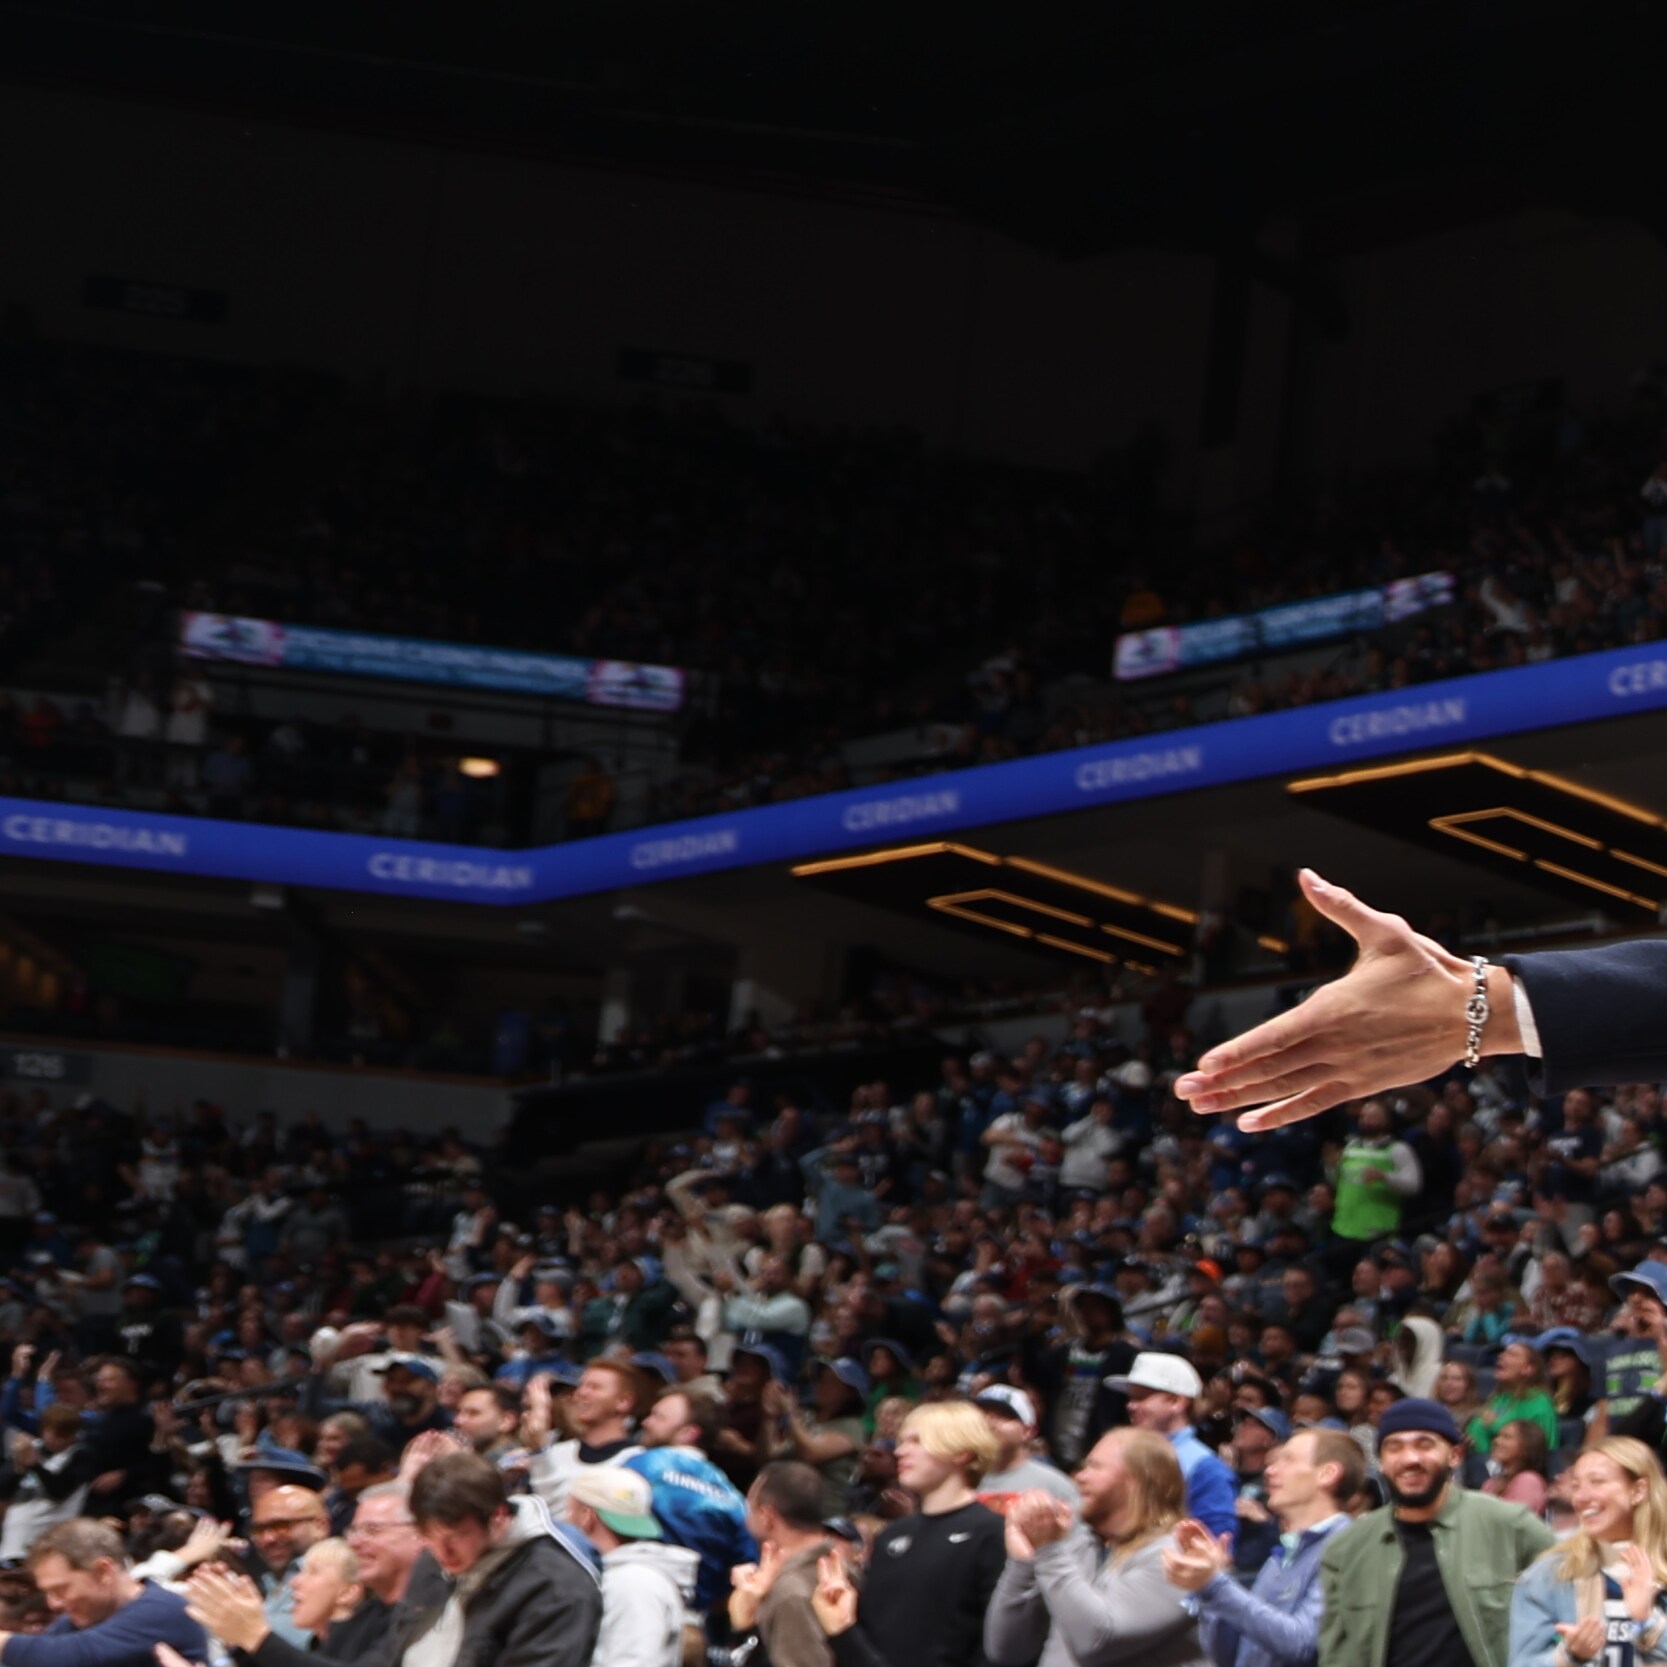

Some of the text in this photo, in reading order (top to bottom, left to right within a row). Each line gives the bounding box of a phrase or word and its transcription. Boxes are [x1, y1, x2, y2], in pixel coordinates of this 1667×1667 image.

[1330, 698, 1467, 745] CERIDIAN
[1078, 747, 1201, 789] CERIDIAN
[845, 791, 958, 830] CERIDIAN
[4, 814, 187, 856] CERIDIAN
[632, 830, 737, 868] CERIDIAN
[369, 853, 532, 890] CERIDIAN
